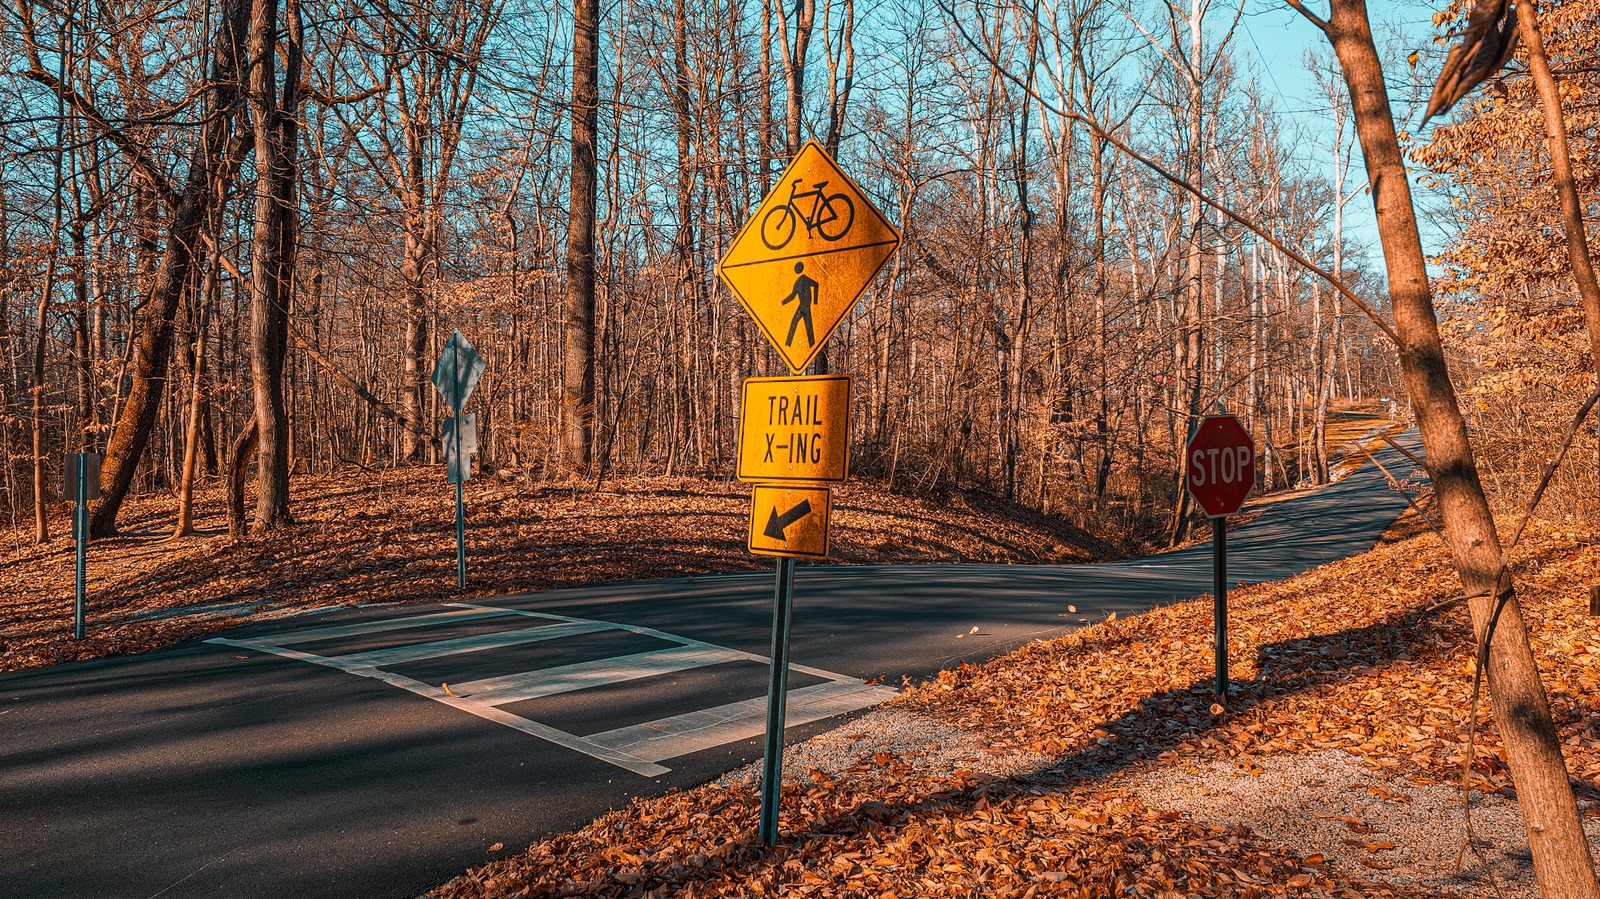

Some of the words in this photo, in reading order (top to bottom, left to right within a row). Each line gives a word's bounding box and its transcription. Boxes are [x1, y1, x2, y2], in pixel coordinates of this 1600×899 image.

[768, 394, 822, 426] TRAIL
[763, 432, 822, 465] X-ING
[1192, 446, 1251, 487] STOP
